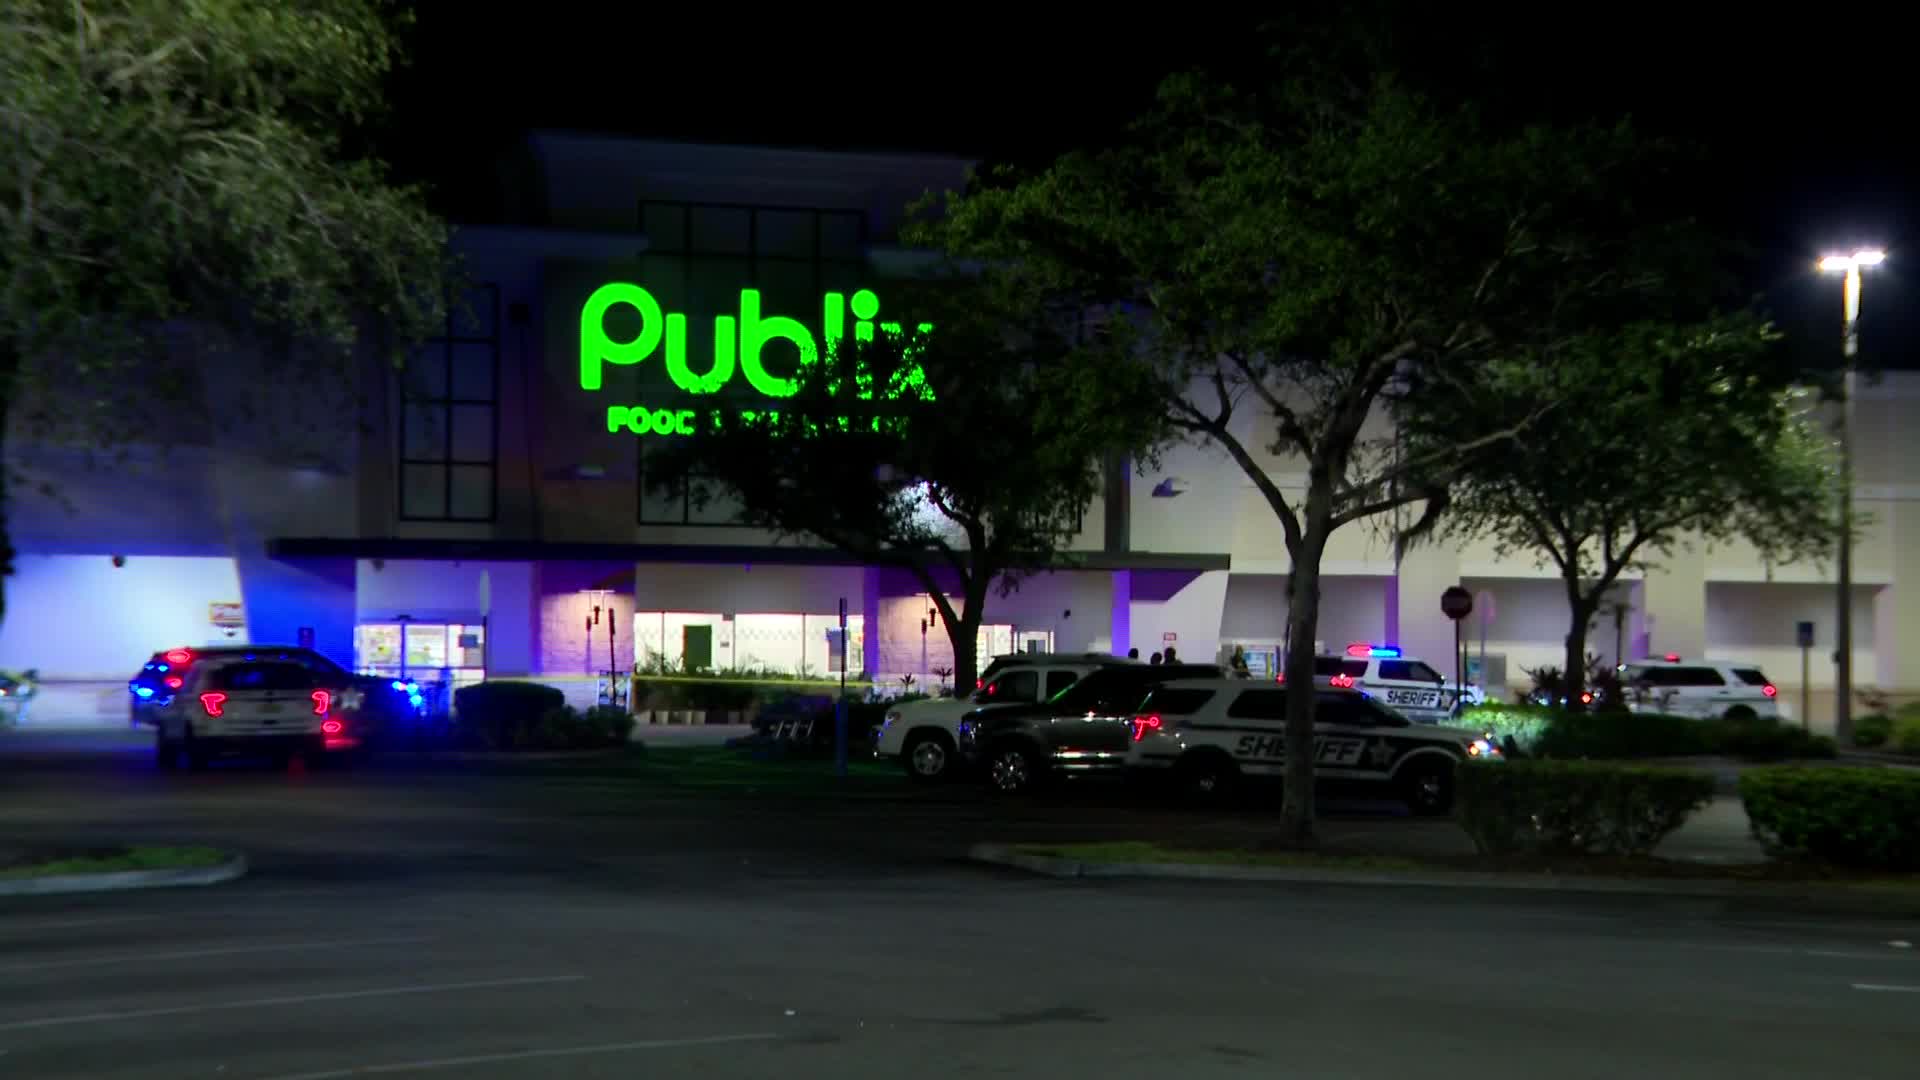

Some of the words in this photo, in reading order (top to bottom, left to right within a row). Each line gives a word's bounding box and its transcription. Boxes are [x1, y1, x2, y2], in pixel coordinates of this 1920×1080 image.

[580, 281, 936, 401] Publix
[1386, 690, 1437, 705] SHERIFF
[1235, 735, 1361, 762] SHEIFF
